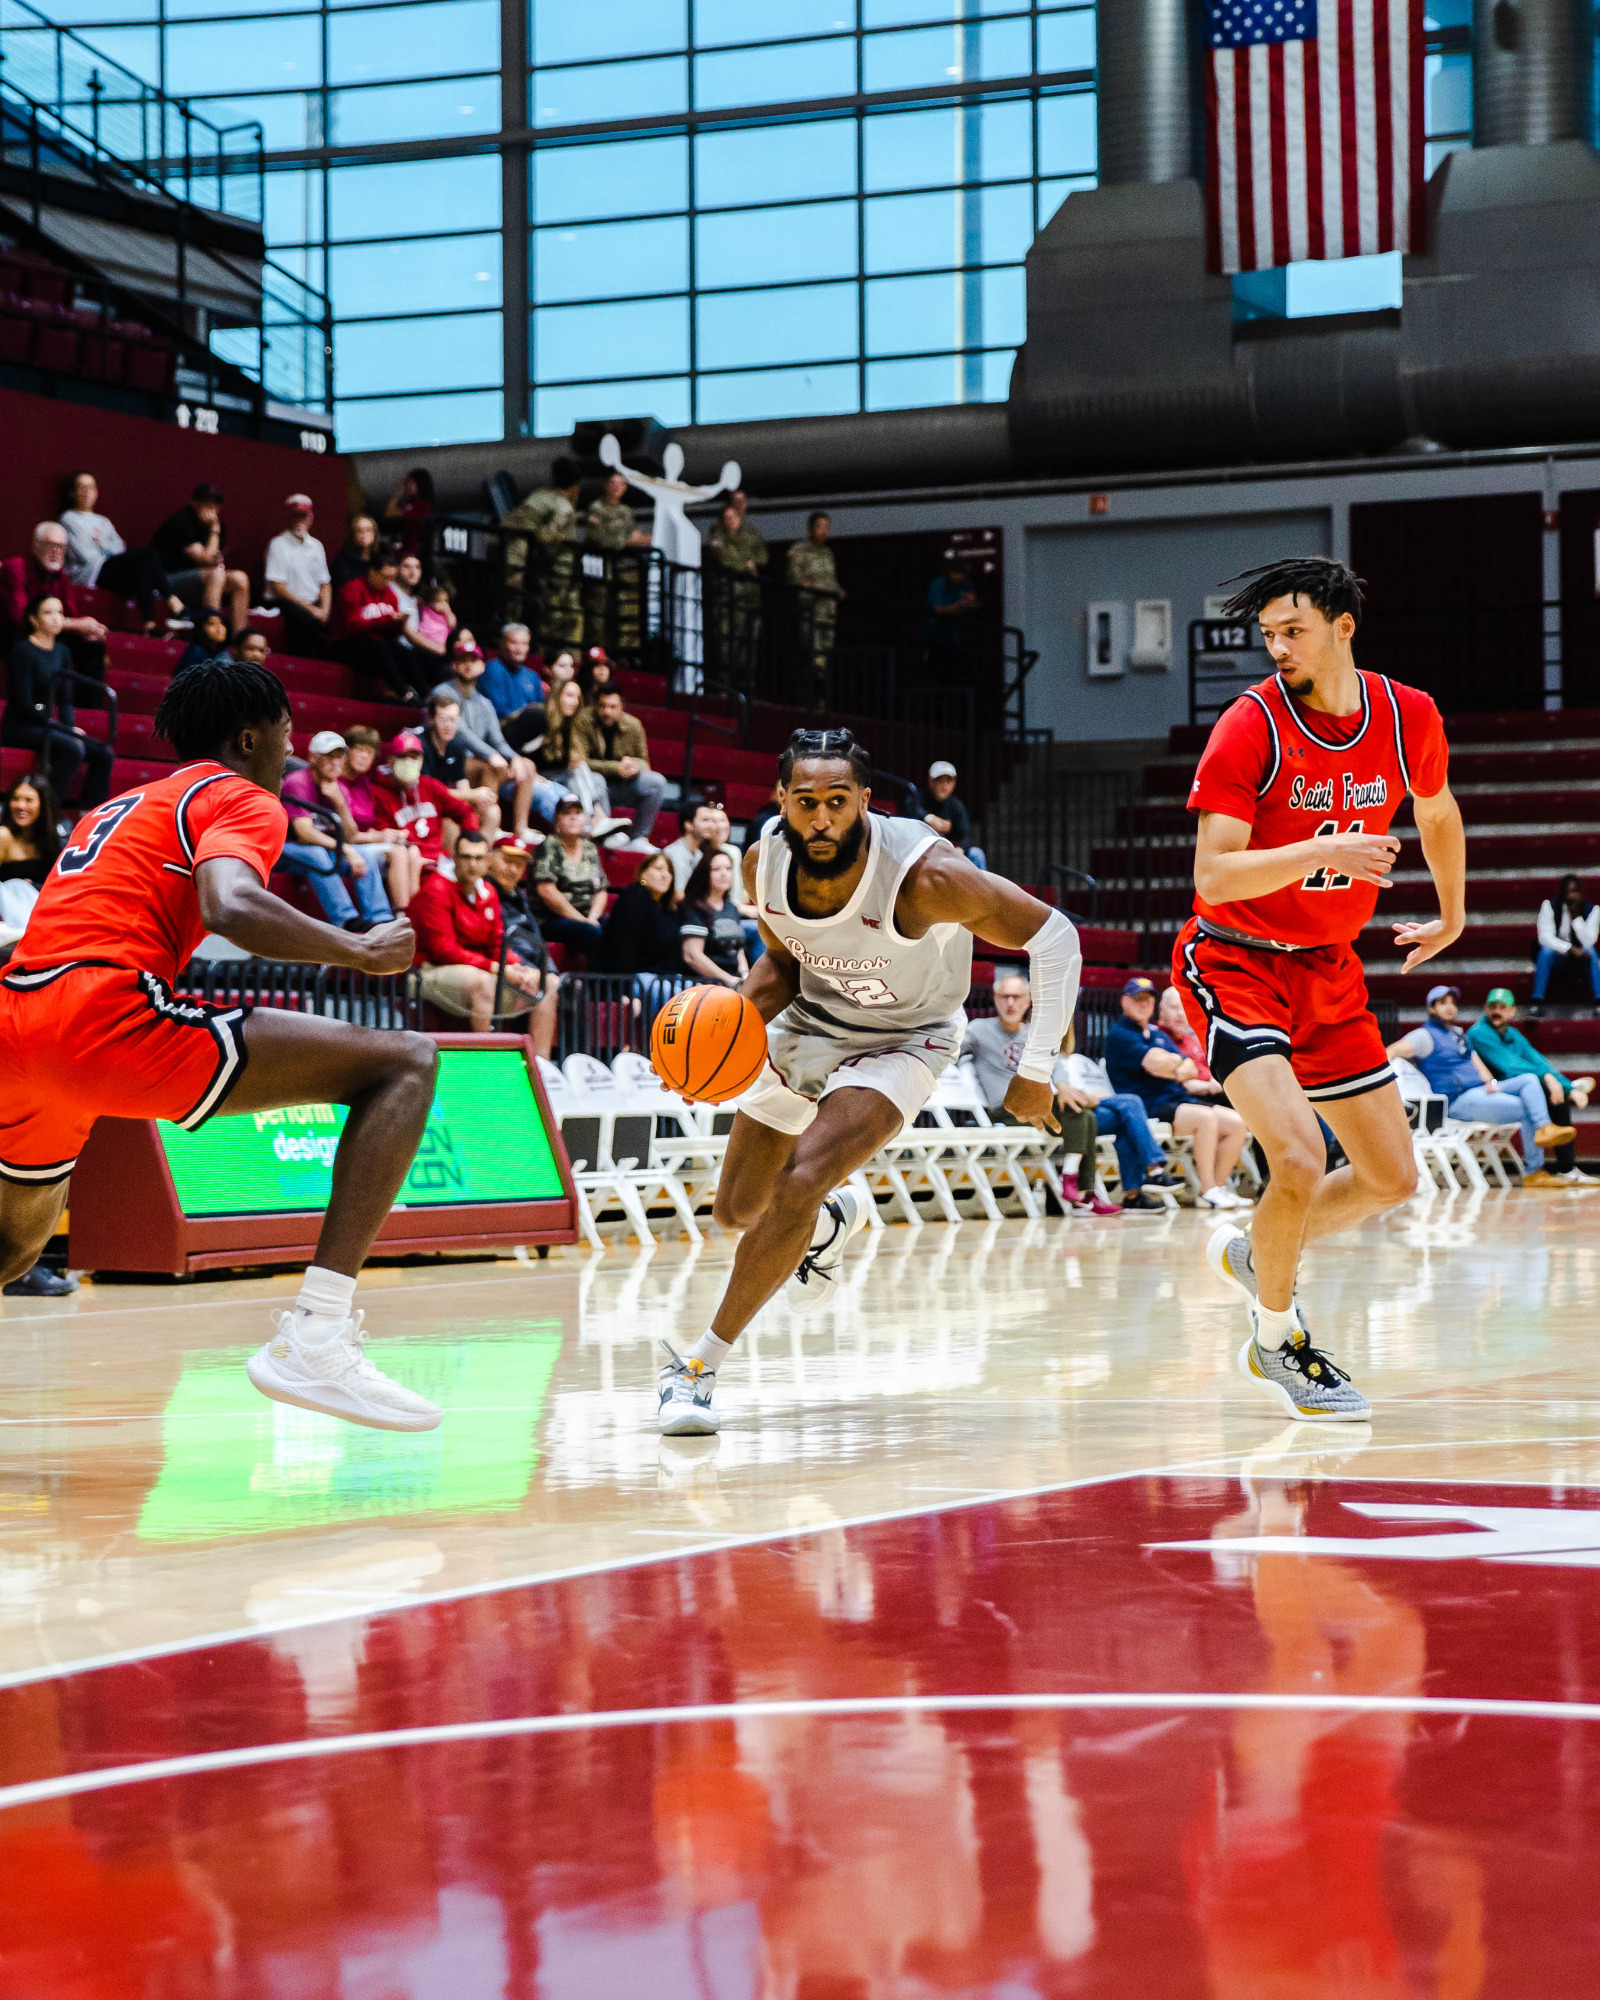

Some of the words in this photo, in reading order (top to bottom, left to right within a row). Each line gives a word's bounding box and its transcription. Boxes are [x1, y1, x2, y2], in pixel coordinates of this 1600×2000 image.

[1210, 626, 1246, 647] 112
[1289, 775, 1333, 811] Saint
[1342, 772, 1387, 811] Francis
[57, 792, 145, 875] 3
[785, 936, 891, 972] Broncos
